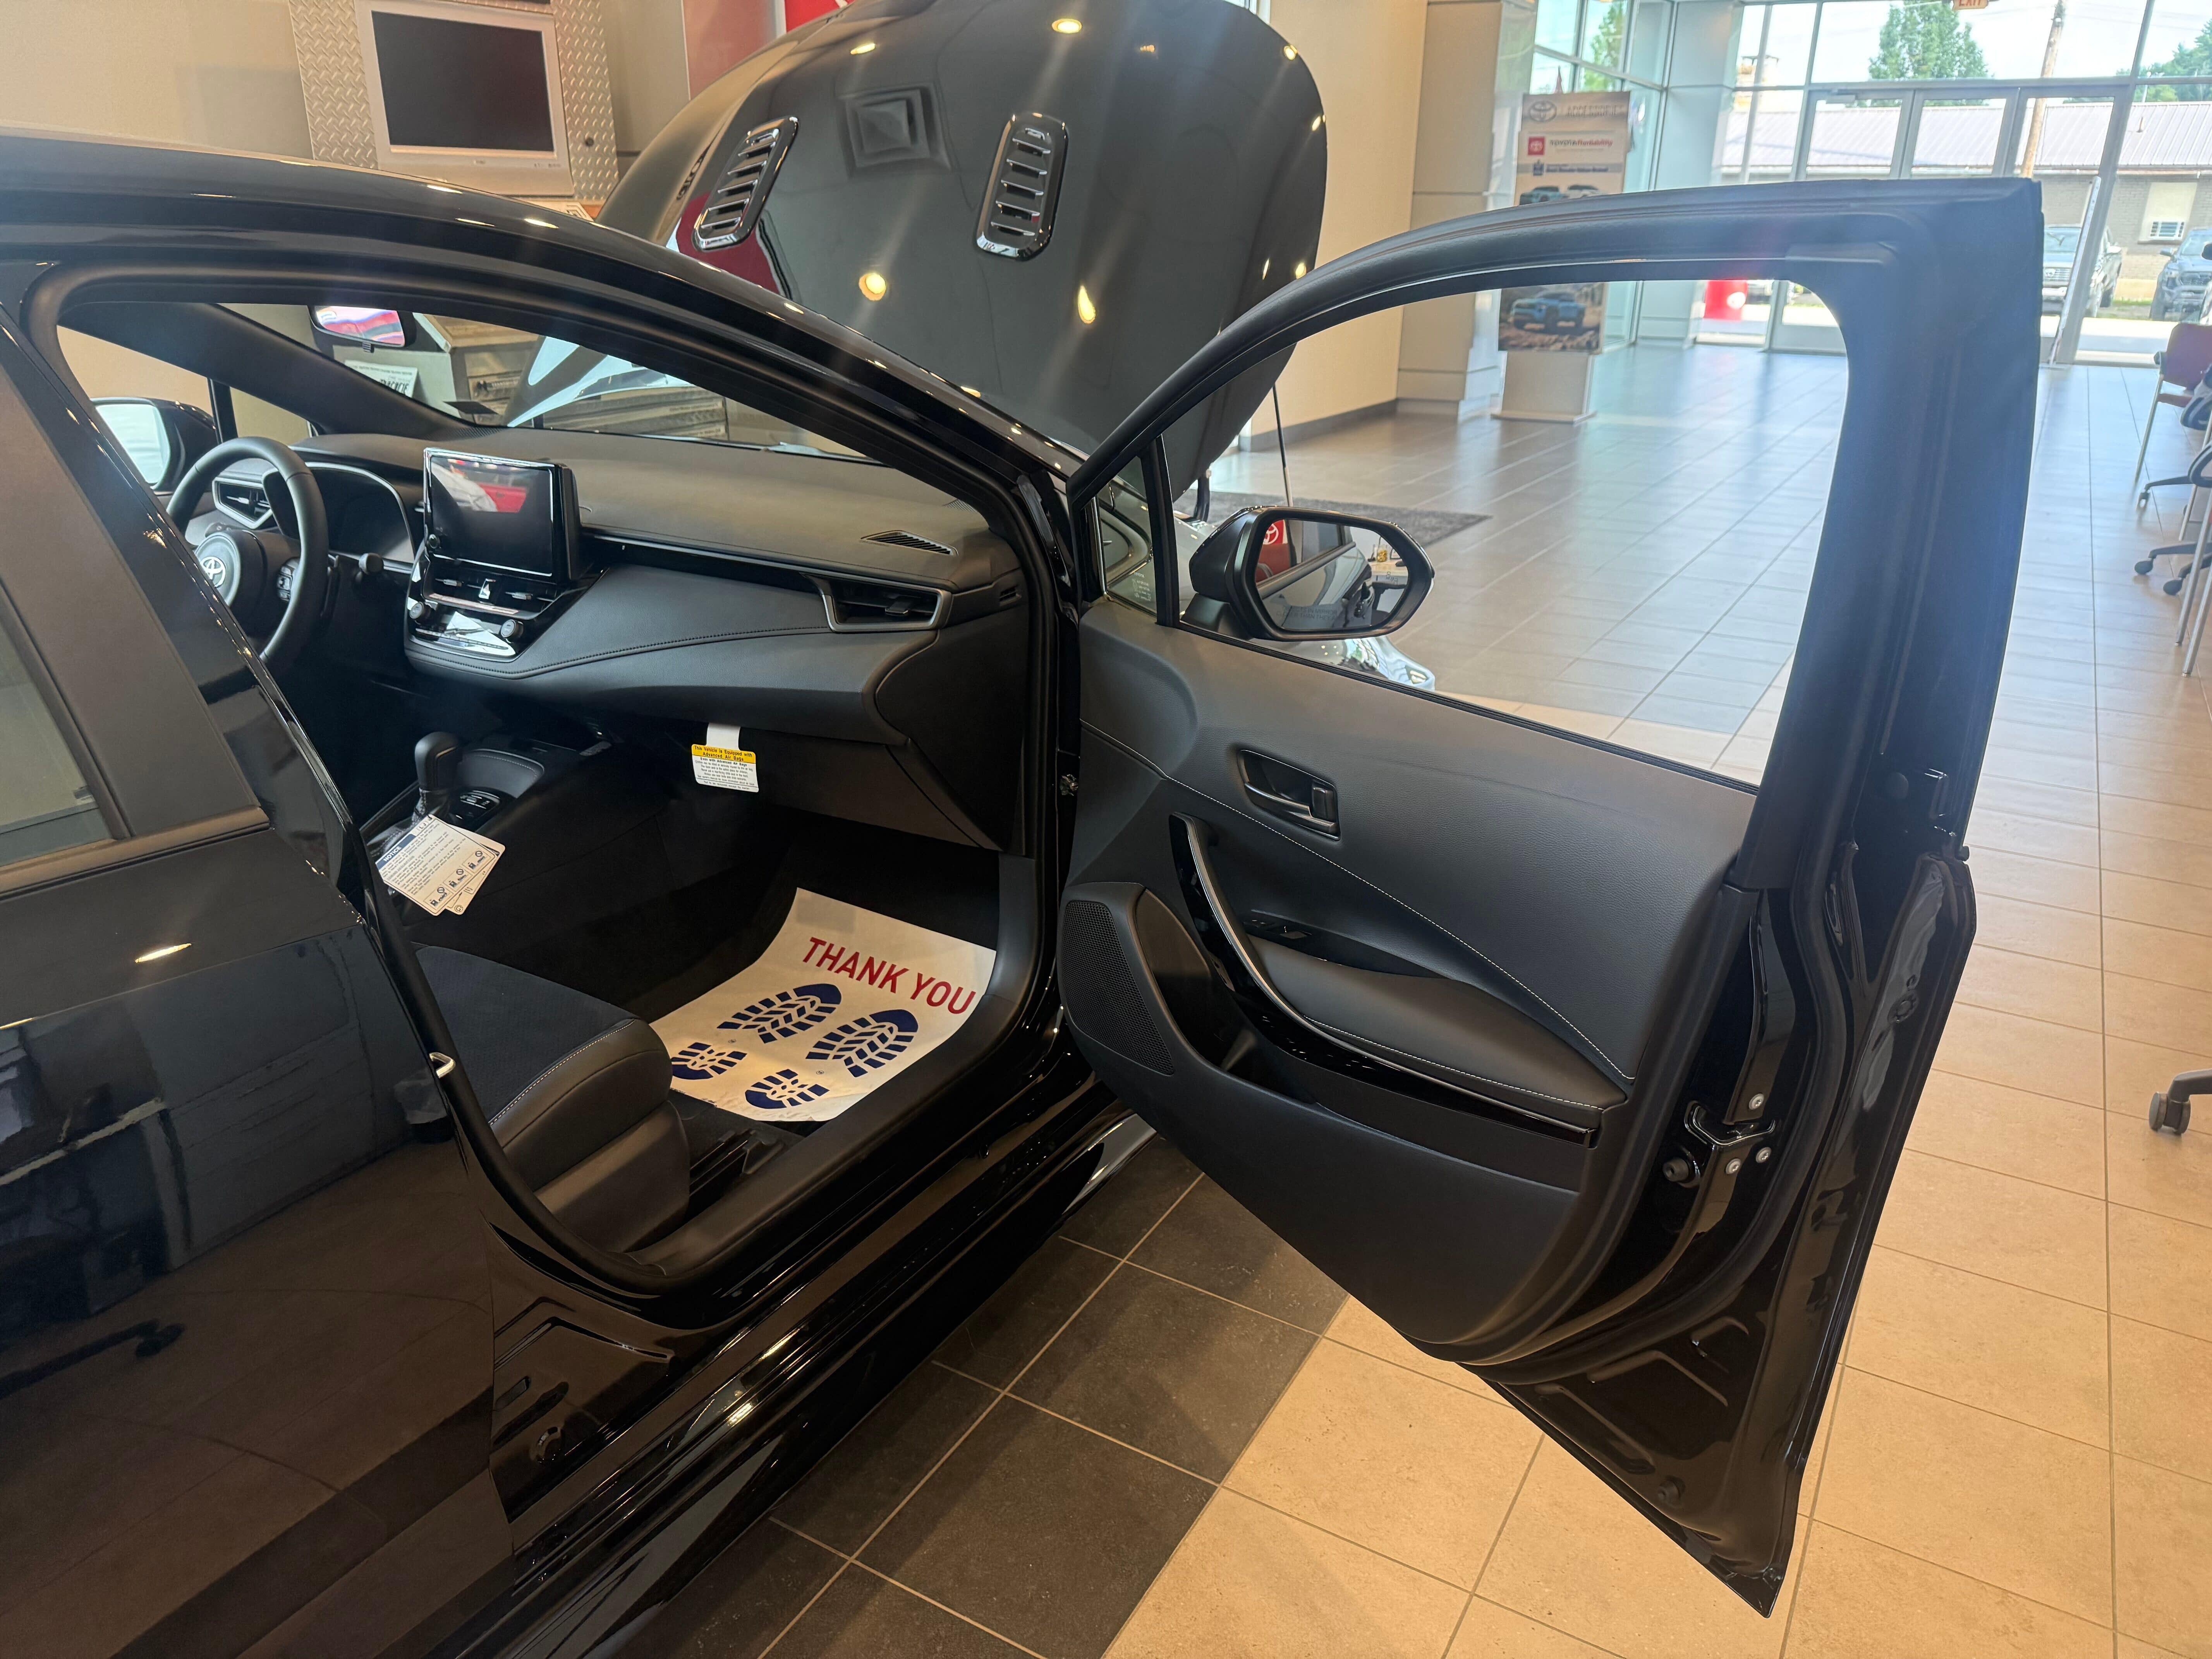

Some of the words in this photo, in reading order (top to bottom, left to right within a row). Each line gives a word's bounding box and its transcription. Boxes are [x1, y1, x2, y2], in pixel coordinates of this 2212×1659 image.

[383, 846, 401, 862] NOTICE
[803, 937, 909, 993] THANK
[910, 972, 976, 1014] YOU
